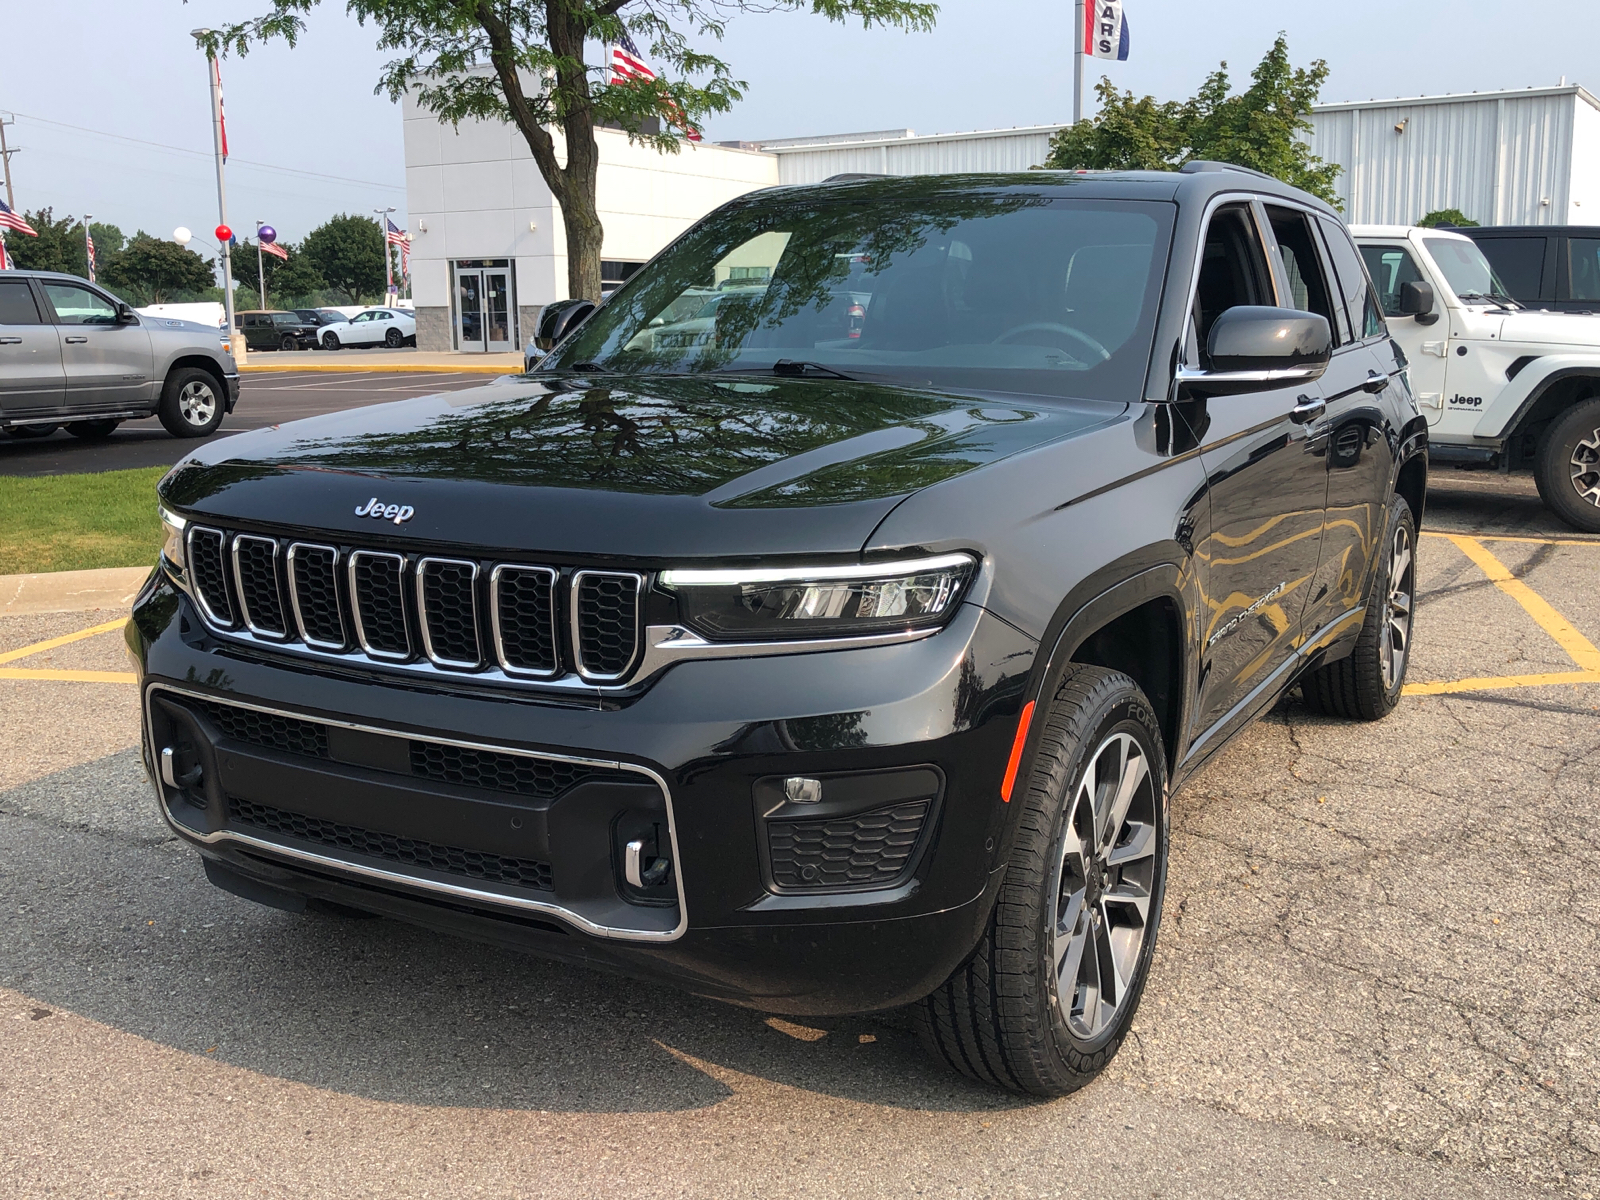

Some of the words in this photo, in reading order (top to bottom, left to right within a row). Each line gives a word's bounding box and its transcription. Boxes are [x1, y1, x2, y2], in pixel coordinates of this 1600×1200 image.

[1099, 0, 1117, 53] ARS
[1449, 393, 1483, 407] Jeep
[354, 497, 415, 525] Jeep
